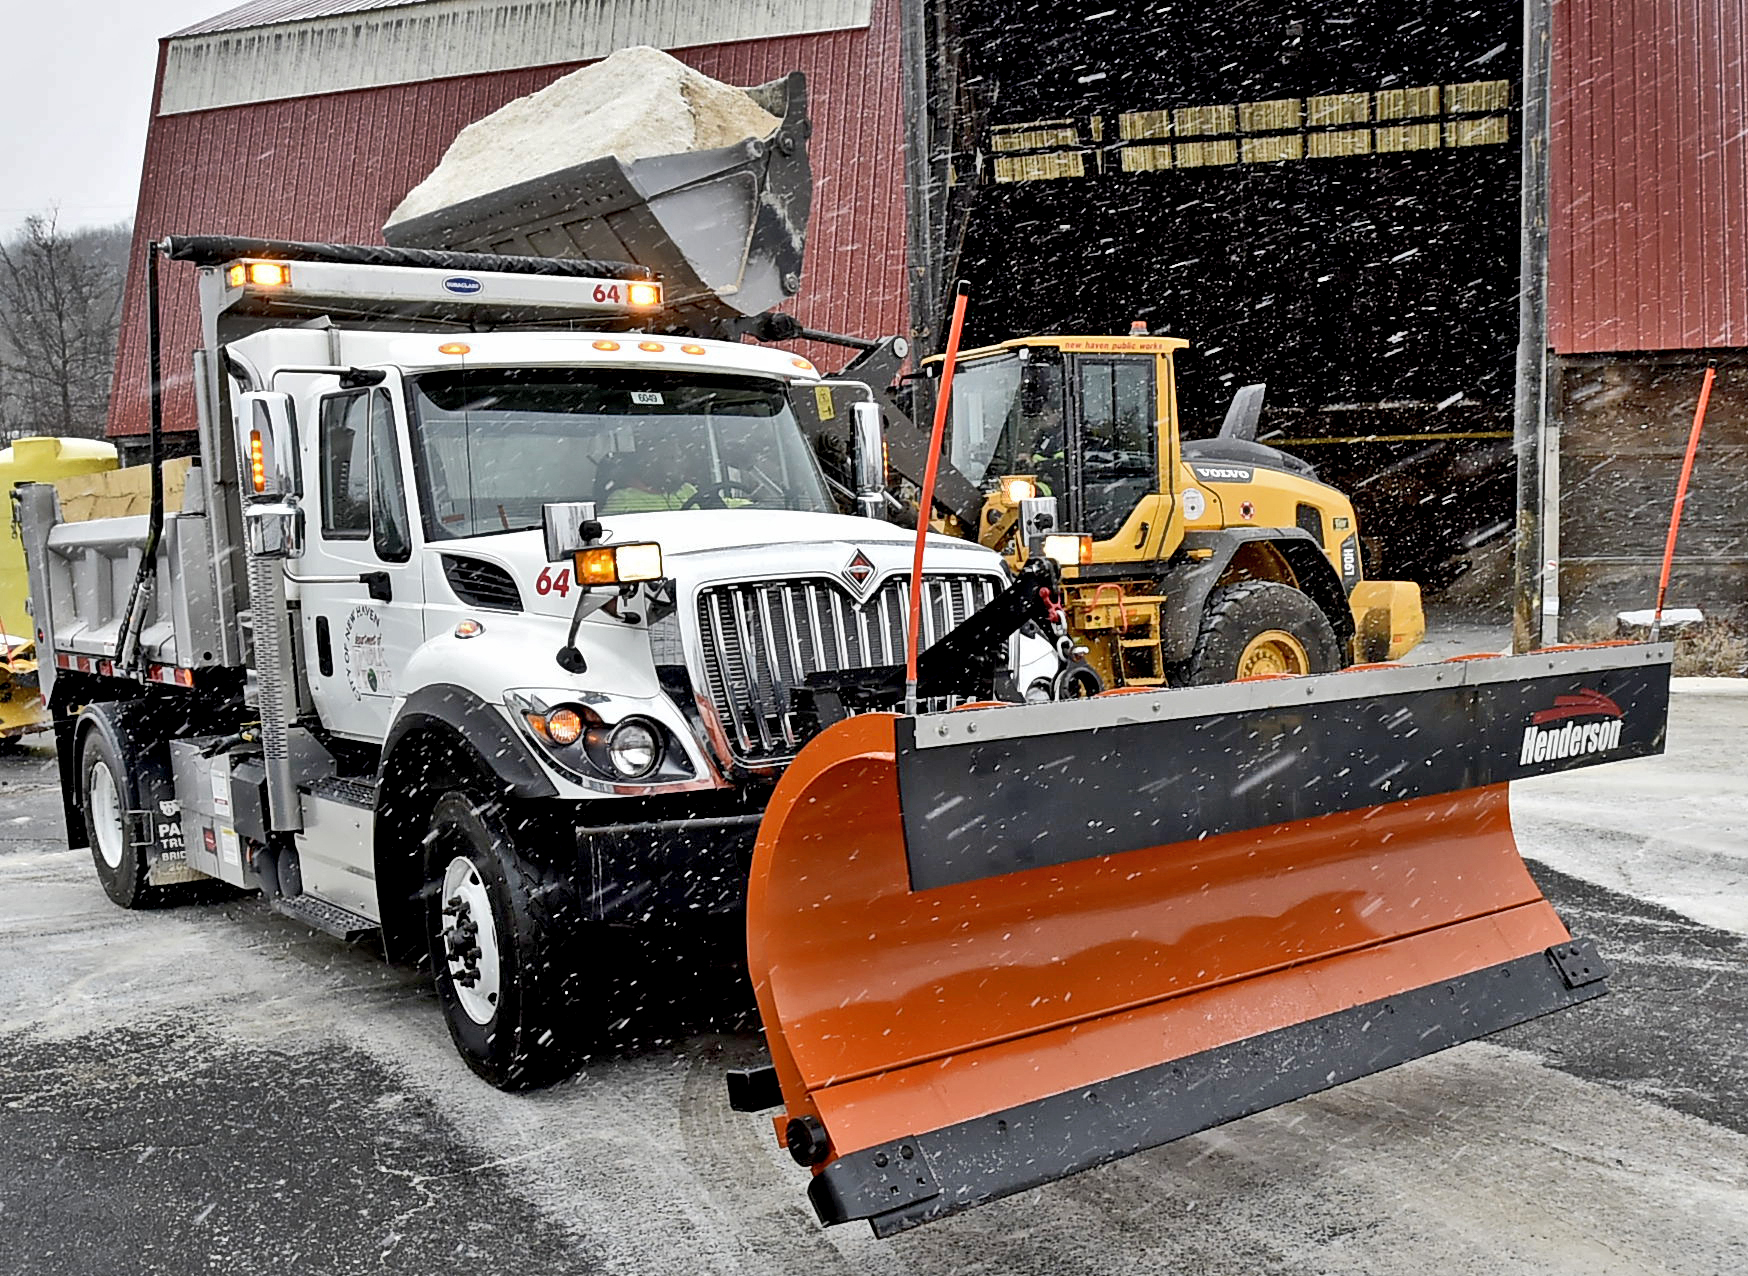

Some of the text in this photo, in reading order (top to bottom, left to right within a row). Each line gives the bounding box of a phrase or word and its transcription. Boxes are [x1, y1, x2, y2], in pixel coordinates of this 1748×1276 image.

[593, 284, 620, 303] 64
[1085, 341, 1109, 349] haven
[1112, 341, 1136, 350] public
[1140, 341, 1163, 350] works
[1197, 468, 1250, 479] VOLVO
[1343, 548, 1355, 576] L90H
[536, 566, 570, 598] 64
[344, 604, 380, 701] CITY OF NEW HAVEN
[1520, 719, 1622, 766] Henderson
